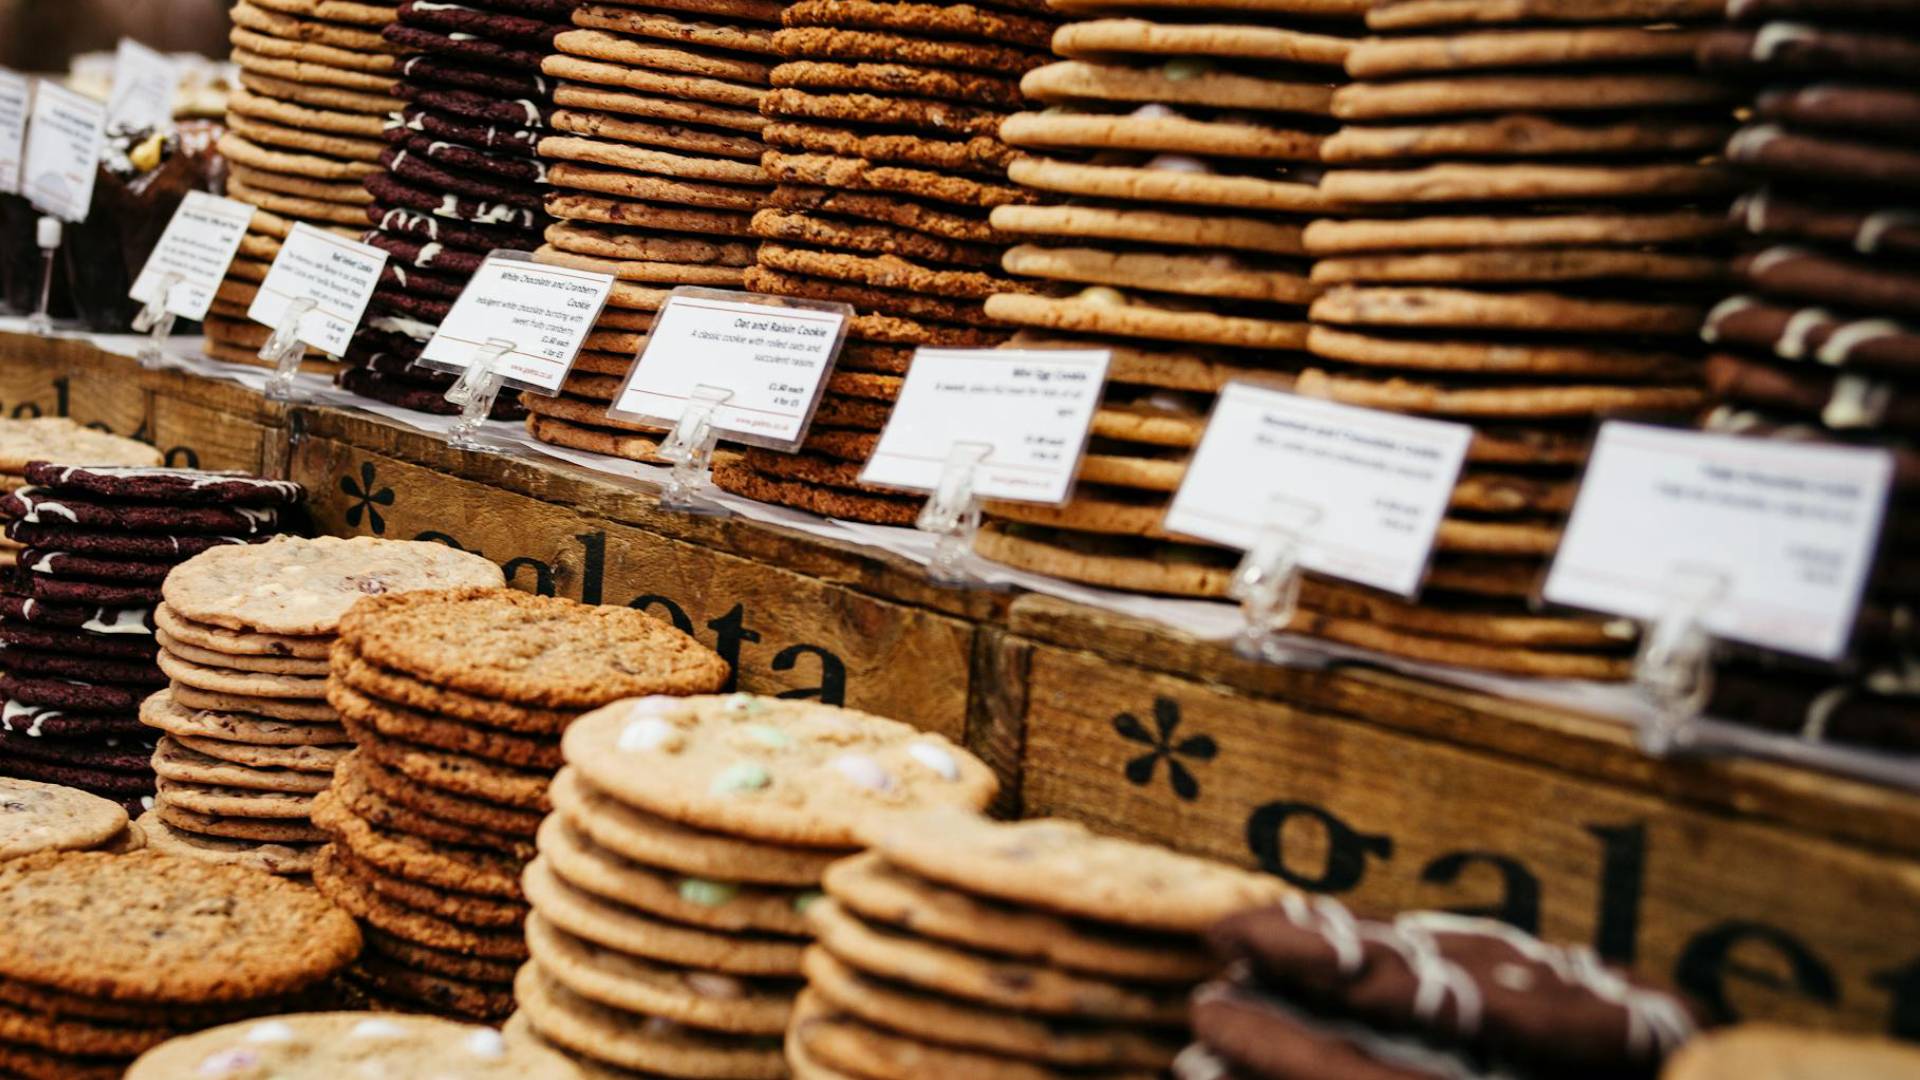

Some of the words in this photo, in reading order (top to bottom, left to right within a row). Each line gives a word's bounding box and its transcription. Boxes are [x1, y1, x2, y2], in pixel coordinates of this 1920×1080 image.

[501, 272, 520, 282] White
[520, 275, 552, 287] Chocolate
[551, 281, 566, 289] and
[565, 282, 598, 296] Cranberry
[502, 302, 518, 310] white
[517, 305, 545, 315] chocolate
[567, 298, 591, 310] Cookie
[734, 318, 751, 329] Oat
[752, 322, 768, 331] and
[770, 322, 796, 333] Raisin
[798, 325, 827, 337] Cookie
[698, 331, 721, 341] classic
[722, 335, 747, 344] cookie
[749, 338, 764, 346] with
[767, 340, 788, 349] rolled
[789, 343, 805, 351] oats
[806, 345, 822, 353] and
[755, 355, 791, 365] succulent
